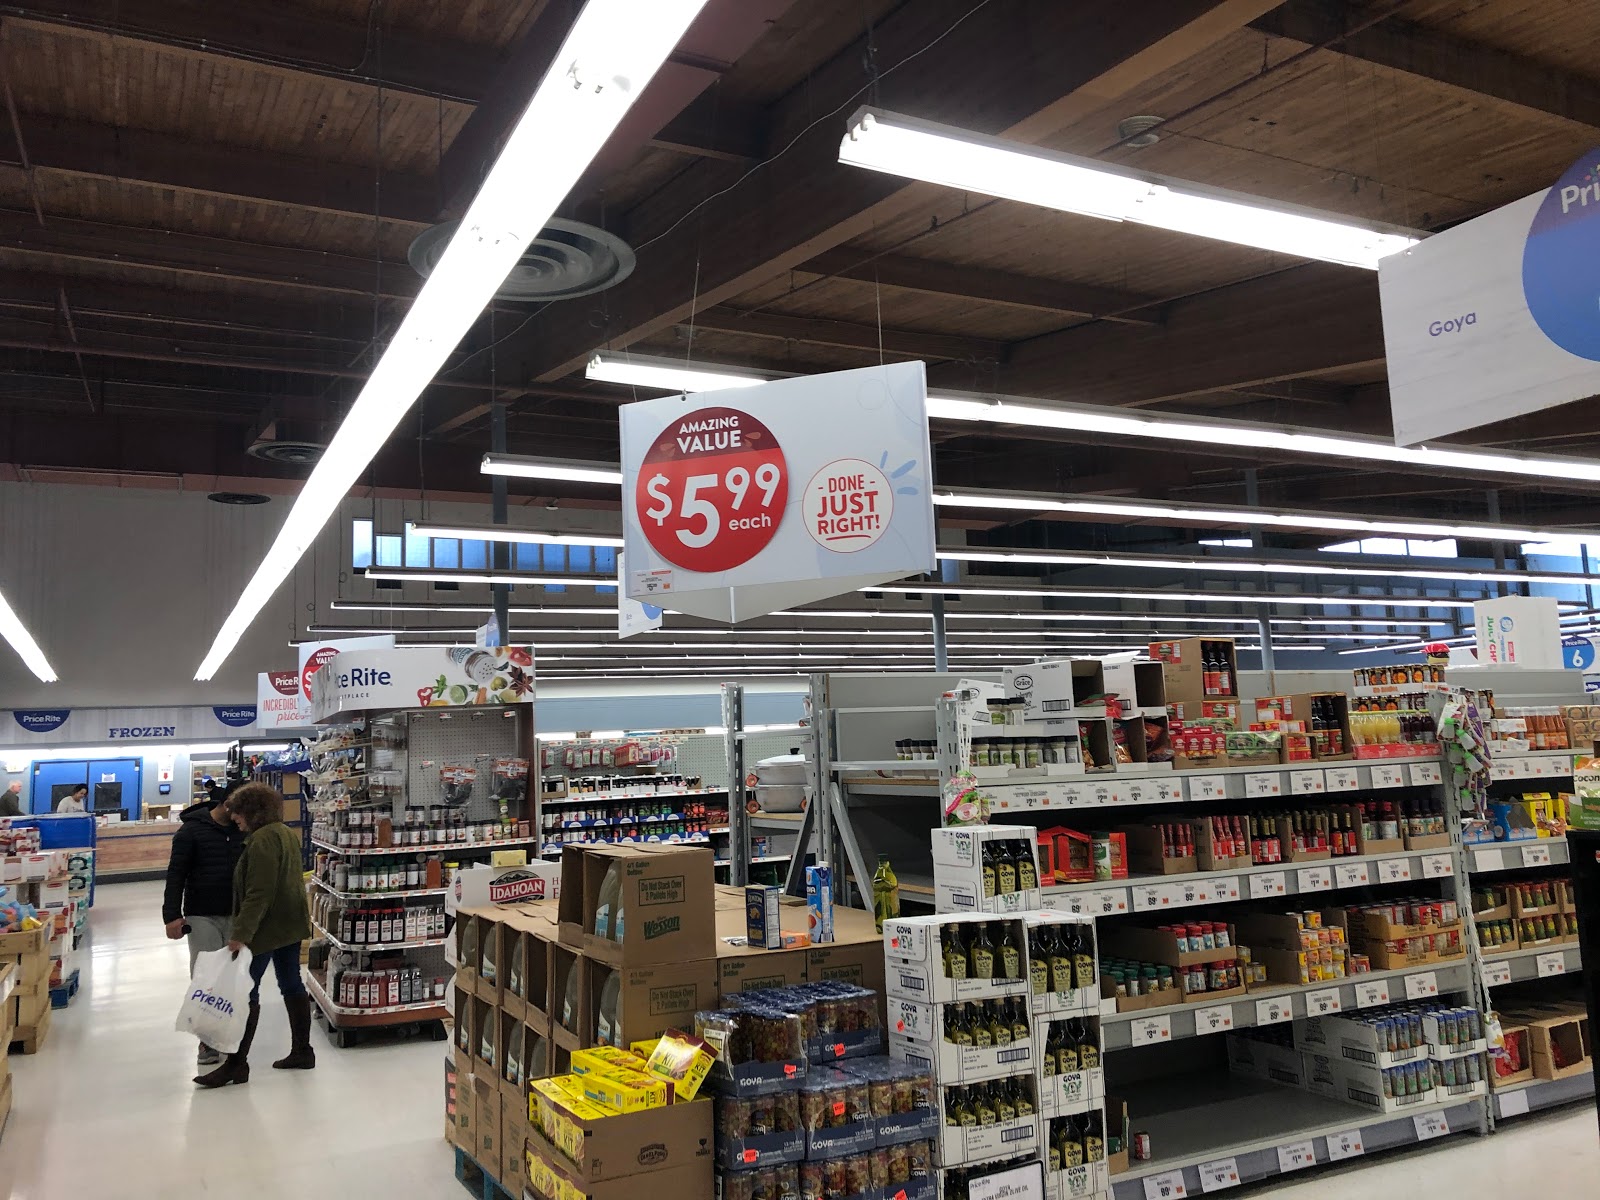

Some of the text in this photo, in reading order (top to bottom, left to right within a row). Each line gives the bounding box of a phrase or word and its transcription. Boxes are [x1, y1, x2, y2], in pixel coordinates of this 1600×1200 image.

[1429, 312, 1477, 337] Goya
[679, 415, 739, 435] AMAZING
[676, 430, 742, 454] VALUE
[828, 474, 865, 491] DONE
[817, 491, 879, 518] JUST
[728, 513, 772, 531] each
[817, 514, 881, 535] RIGHT!
[1572, 649, 1584, 667] 6
[351, 667, 391, 687] Rite
[276, 711, 301, 726] price
[109, 726, 176, 739] FROZEN
[955, 832, 970, 840] GOYA
[492, 880, 543, 900] IDAHOAN
[896, 925, 912, 935] GOYA
[900, 1002, 917, 1013] GOYA
[662, 1052, 676, 1066] KIT
[1062, 1056, 1076, 1064] GOYA
[694, 1062, 706, 1074] KIT
[740, 1077, 762, 1087] GOYA
[1063, 1073, 1081, 1083] GOYA
[880, 1125, 901, 1135] GOYA
[563, 1135, 573, 1151] KIT
[811, 1140, 833, 1150] GOYA
[1068, 1167, 1086, 1176] GOYA
[534, 1173, 544, 1190] KIT
